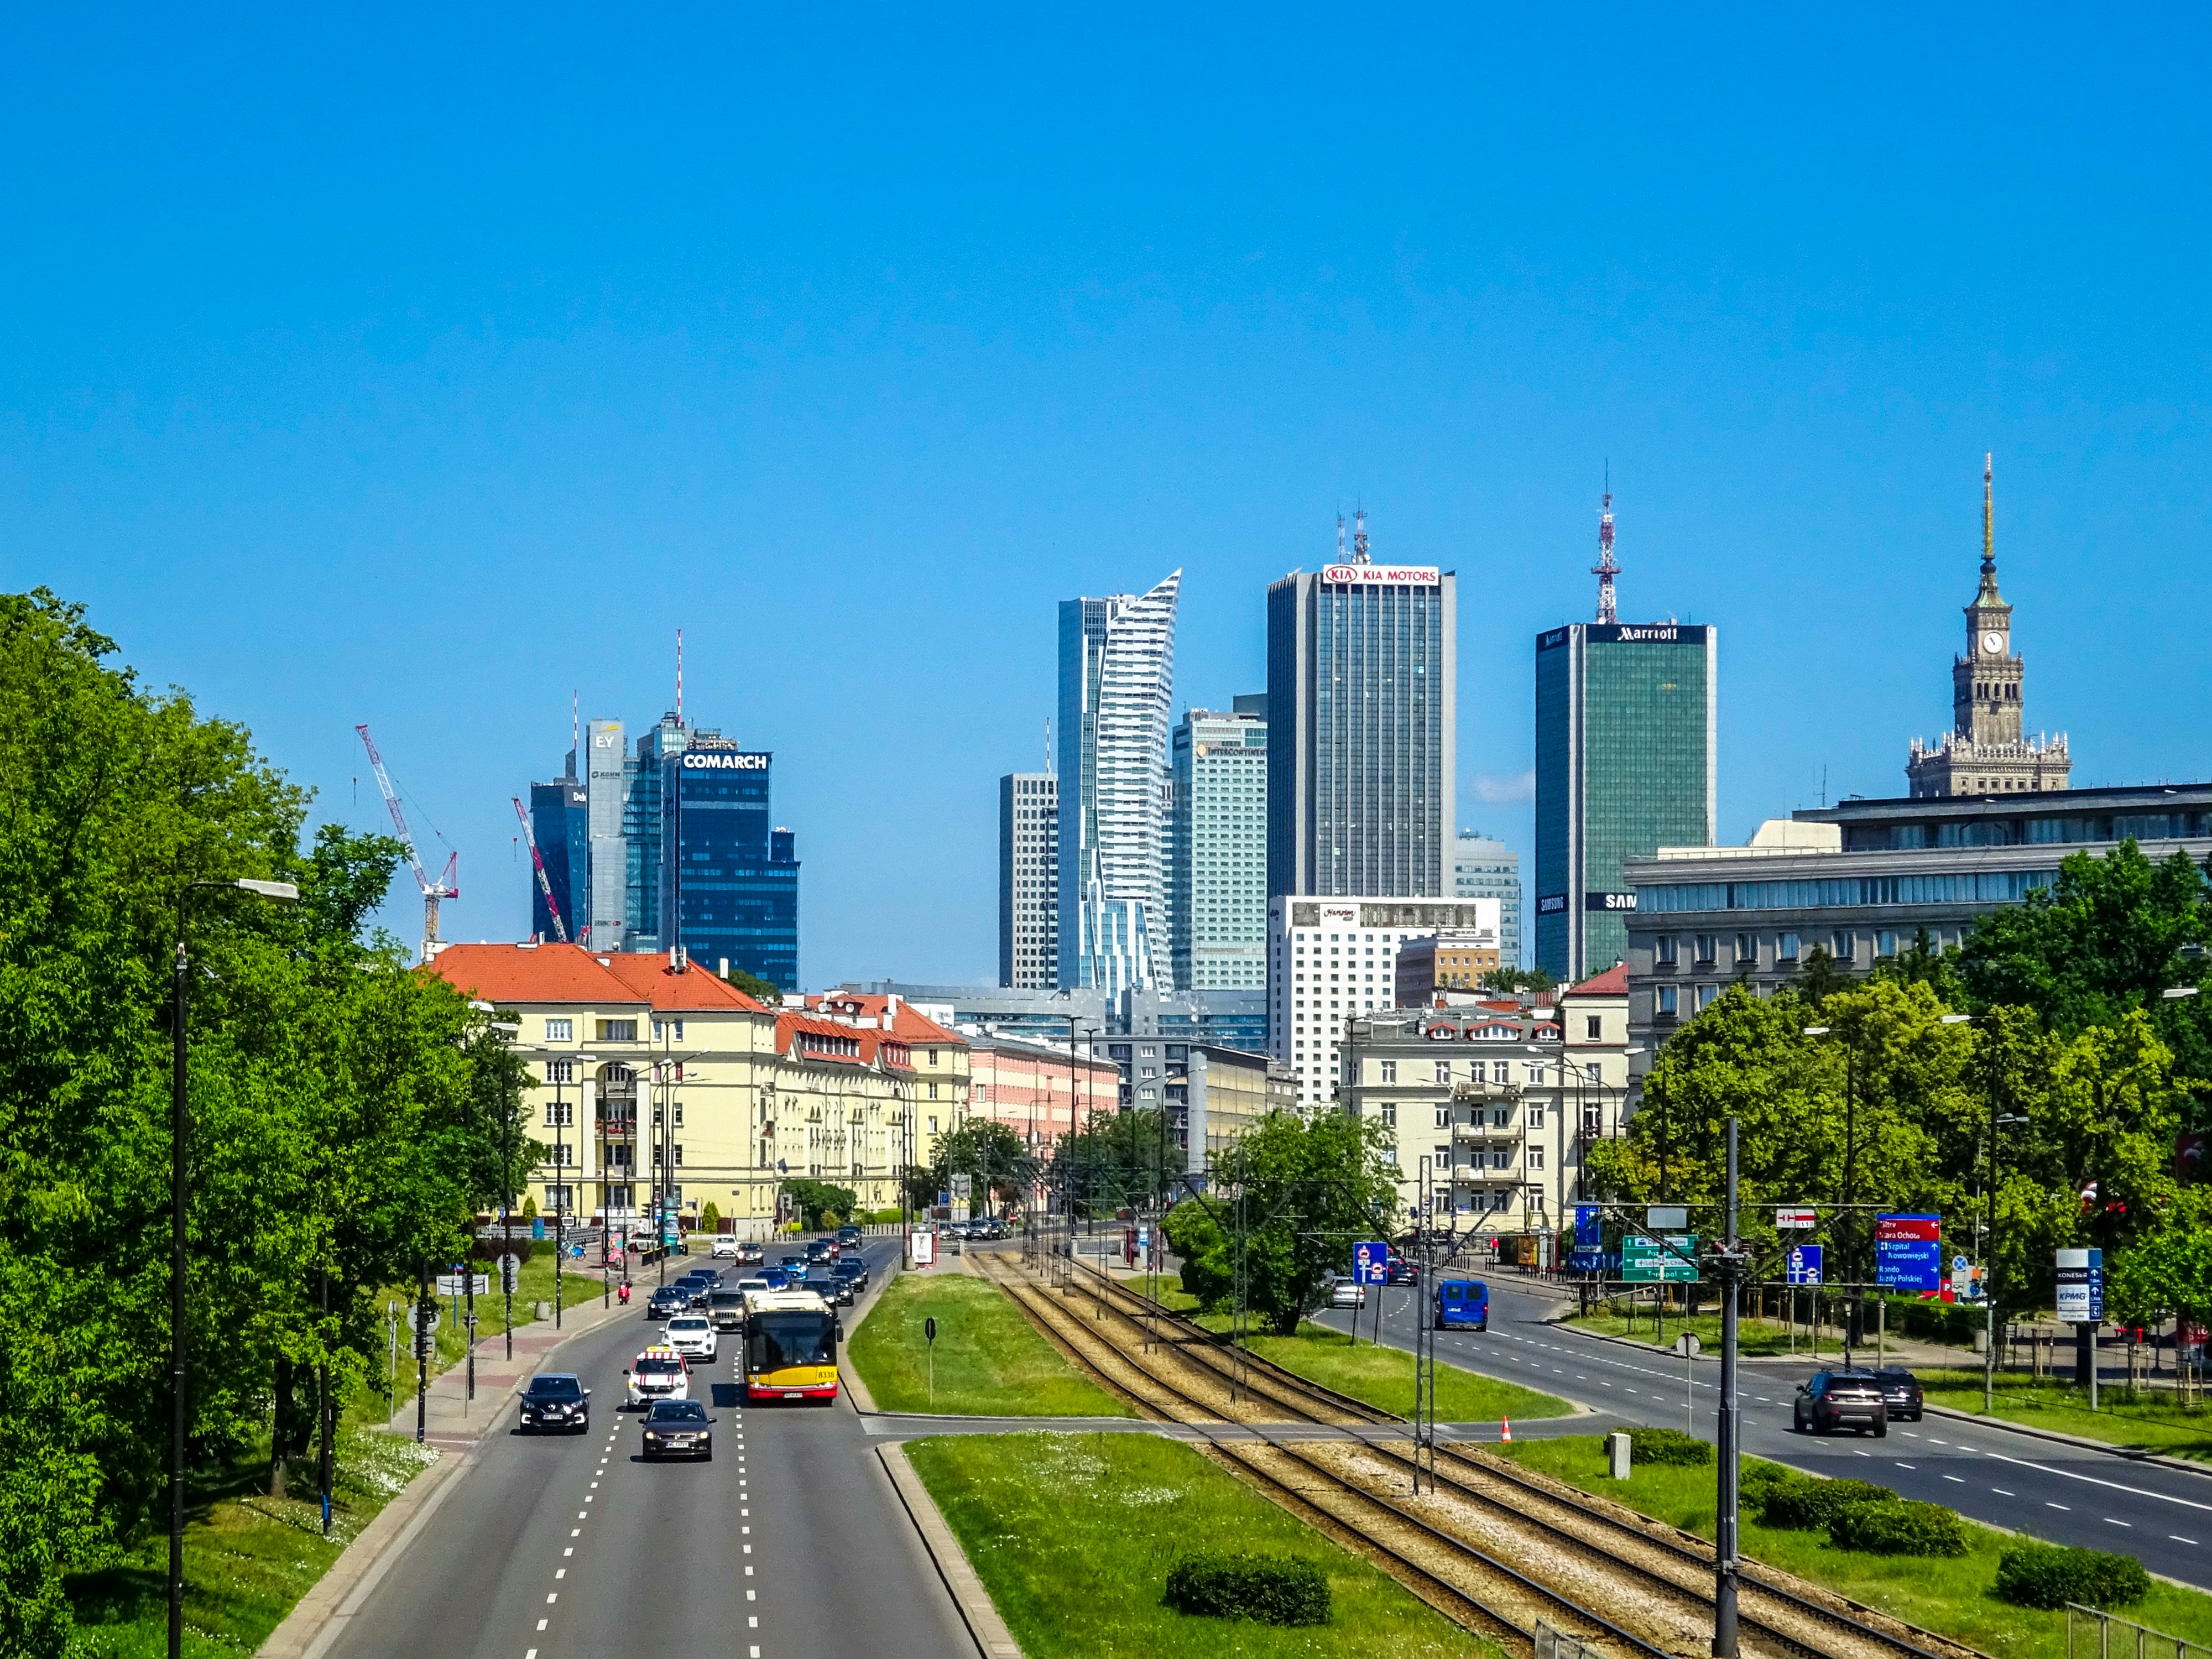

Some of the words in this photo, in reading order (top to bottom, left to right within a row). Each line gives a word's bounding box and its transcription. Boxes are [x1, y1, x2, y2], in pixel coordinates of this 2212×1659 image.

[1331, 570, 1352, 579] KIA
[1364, 570, 1383, 580] KIA
[1387, 571, 1436, 581] MOTORS
[1617, 627, 1678, 641] Marriott
[596, 736, 614, 748] EY
[684, 754, 767, 769] COMARCH
[1541, 896, 1564, 911] SAMSUNG
[1888, 1243, 1910, 1251] Szpital
[1887, 1252, 1929, 1261] Nowowiejski
[1898, 1275, 1922, 1284] Polskiej
